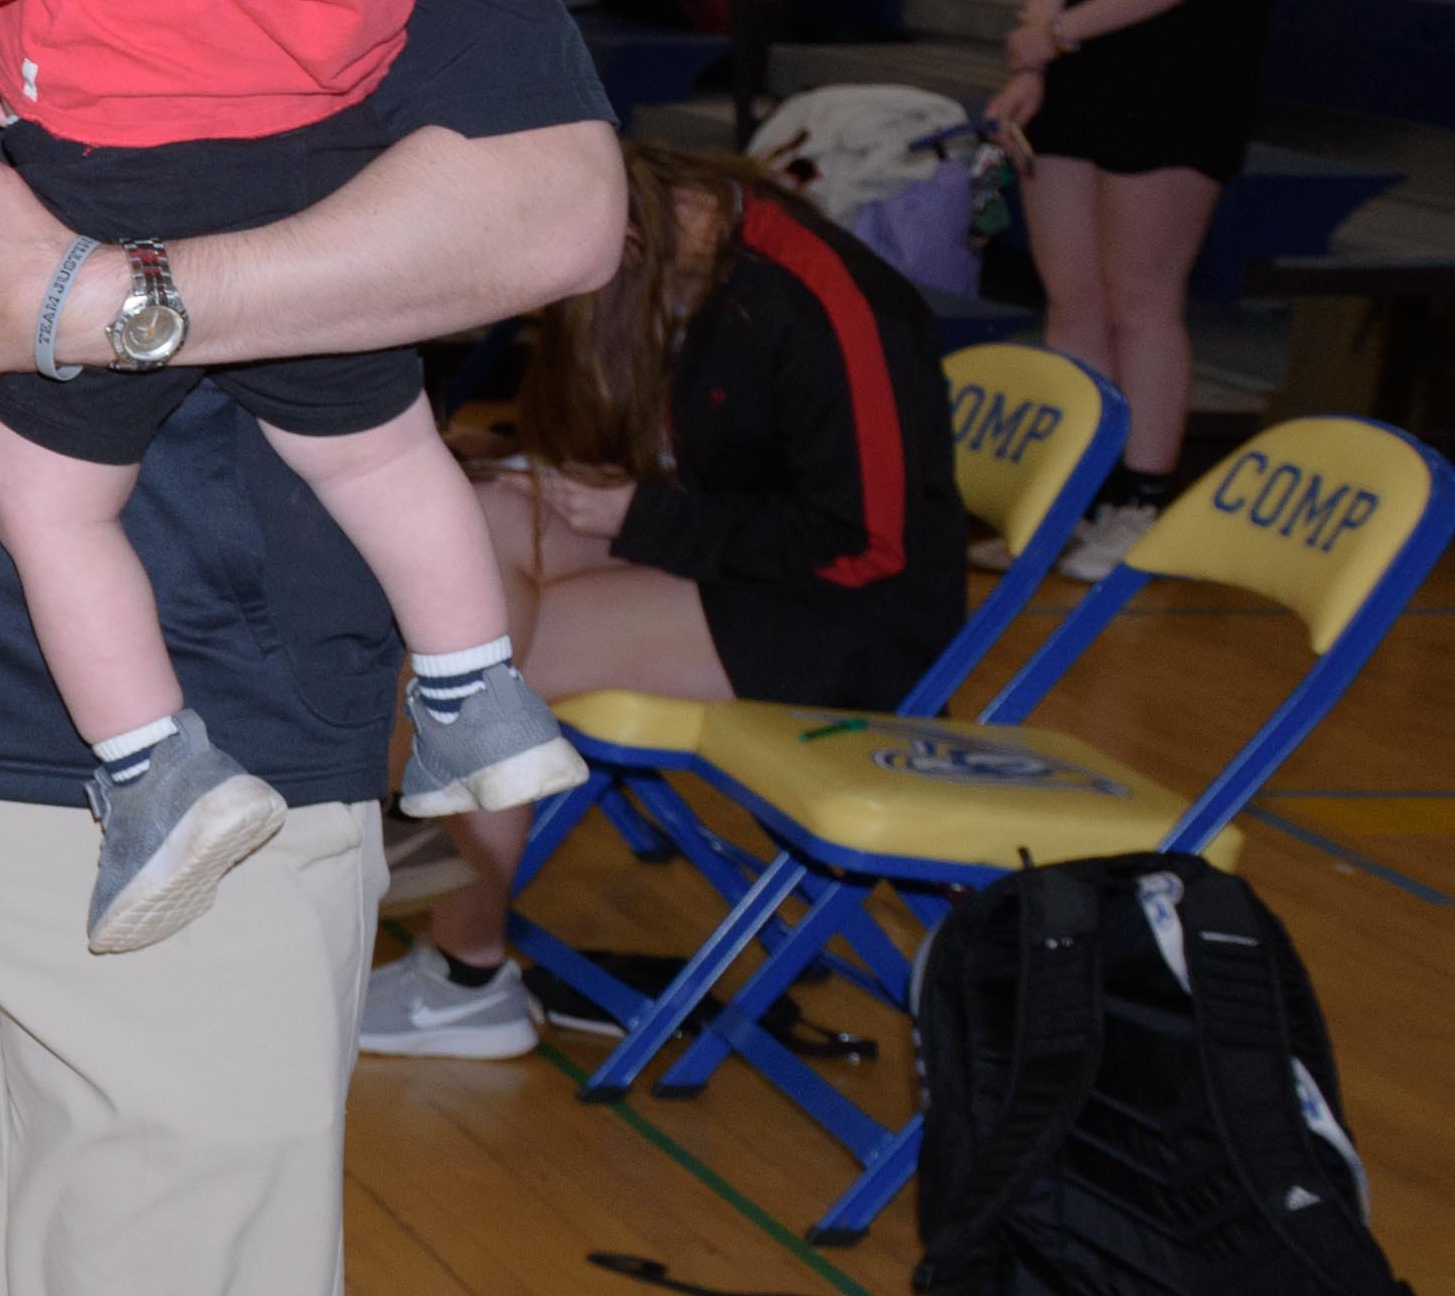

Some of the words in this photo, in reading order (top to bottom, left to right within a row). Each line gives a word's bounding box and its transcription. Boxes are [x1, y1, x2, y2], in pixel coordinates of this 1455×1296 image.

[39, 295, 61, 345] TEAM
[949, 384, 1062, 465] OMP
[1214, 452, 1379, 551] COMP
